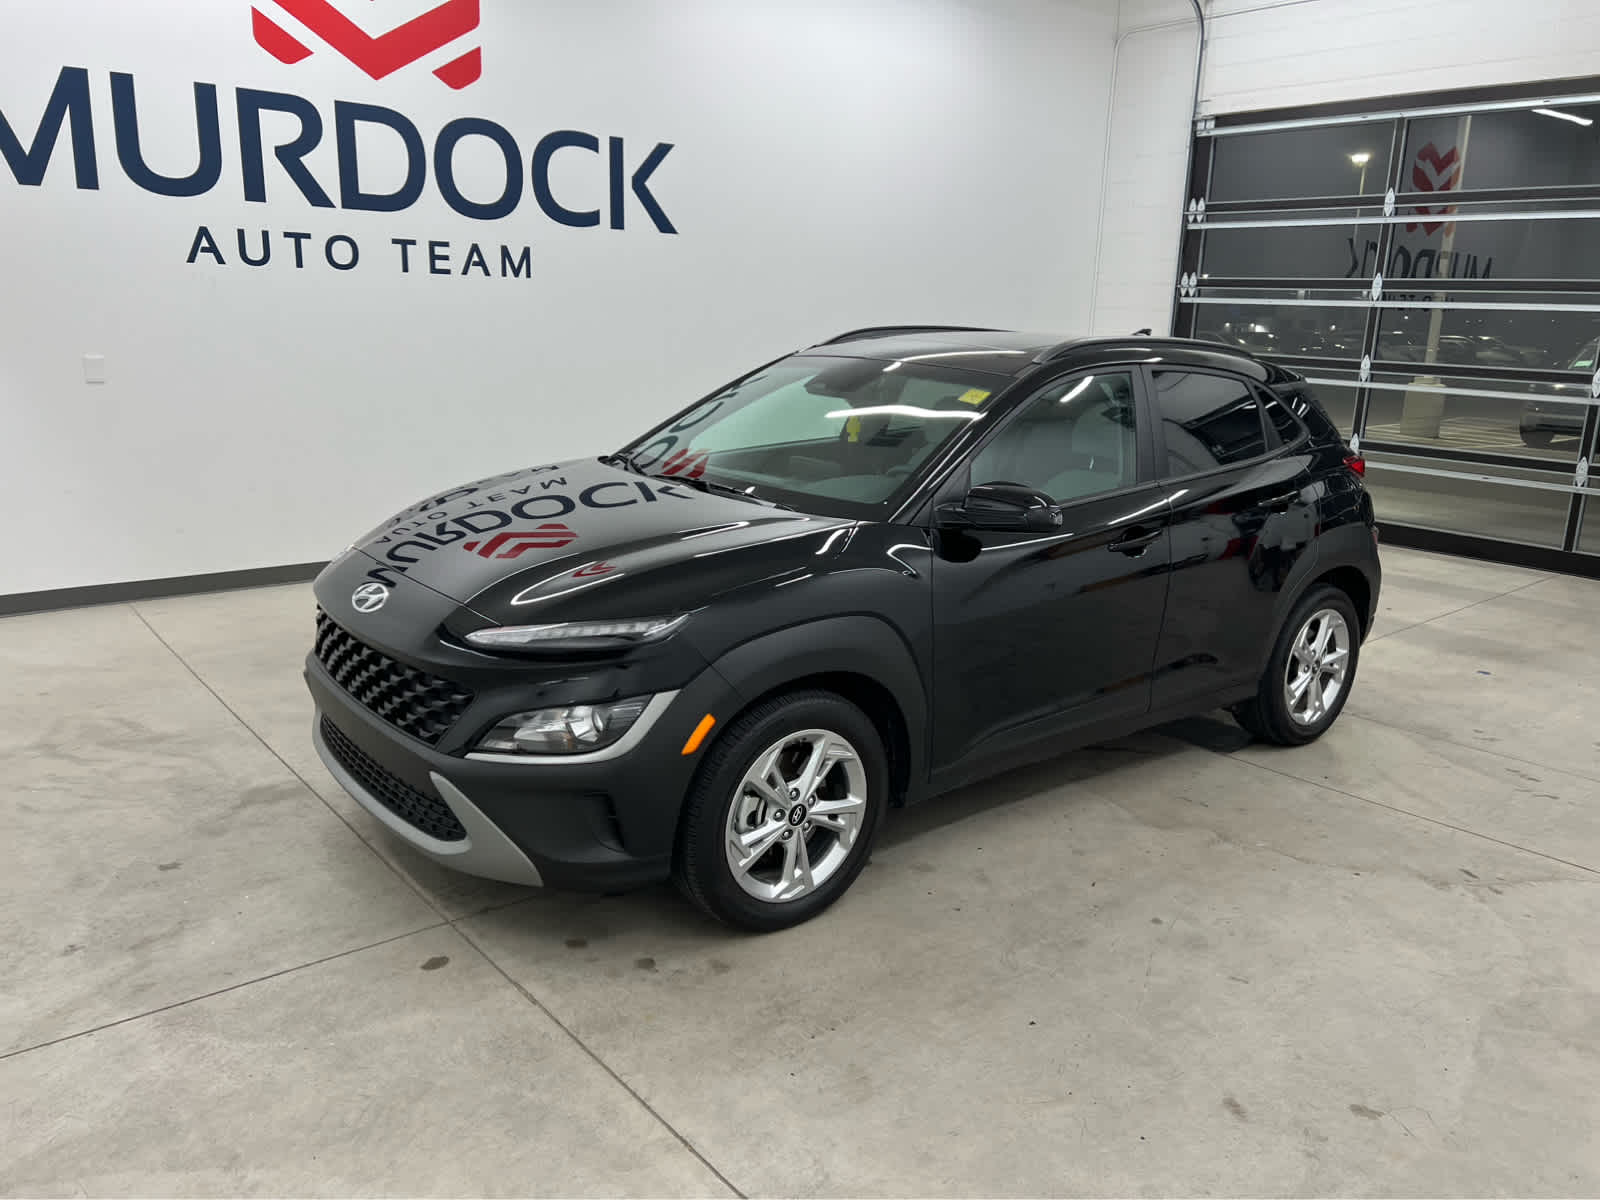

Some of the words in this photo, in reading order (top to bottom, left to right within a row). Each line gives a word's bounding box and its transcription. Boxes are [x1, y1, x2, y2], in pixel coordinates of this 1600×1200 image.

[0, 65, 679, 235] MURDOCK
[186, 225, 360, 271] AUTO
[391, 238, 533, 279] TEAM
